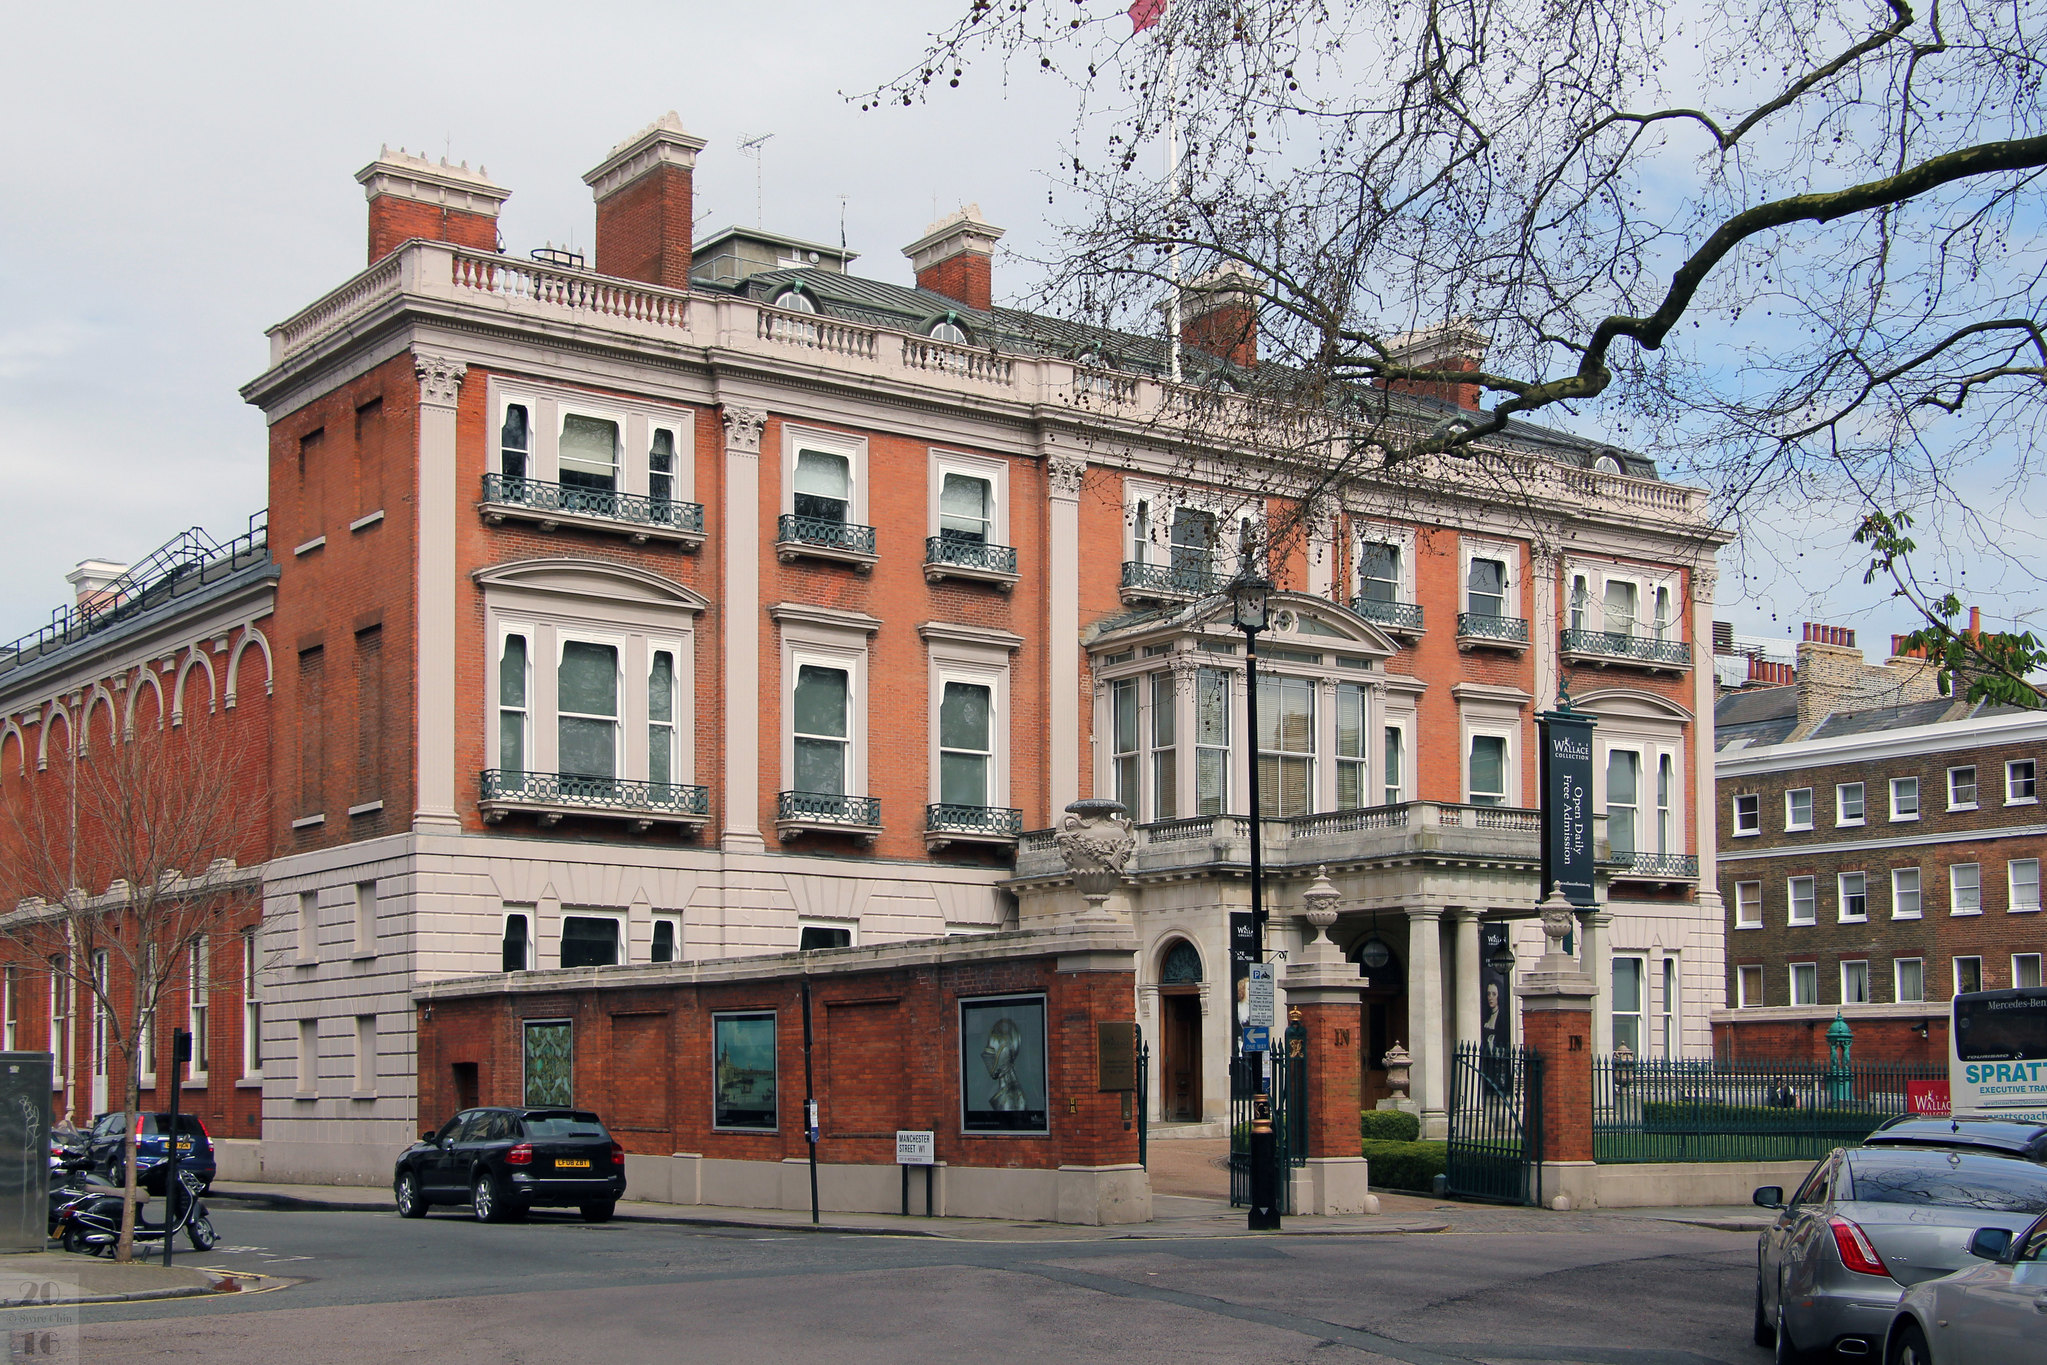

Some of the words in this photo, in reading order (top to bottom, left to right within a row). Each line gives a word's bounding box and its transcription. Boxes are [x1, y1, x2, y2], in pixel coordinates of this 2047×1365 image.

[1553, 739, 1589, 755] WALLACE
[1554, 752, 1589, 761] COLLECTION
[1563, 775, 1572, 800] Free
[1573, 786, 1583, 819] Open
[1563, 803, 1573, 865] Admission
[1573, 823, 1584, 855] Daily
[1334, 1028, 1349, 1047] IN
[1568, 1035, 1582, 1051] IN
[1966, 1062, 2047, 1084] SPRAT
[1980, 1086, 2026, 1094] EXECUTIVE
[899, 1134, 930, 1143] MANCHESTER
[899, 1144, 916, 1153] STREET
